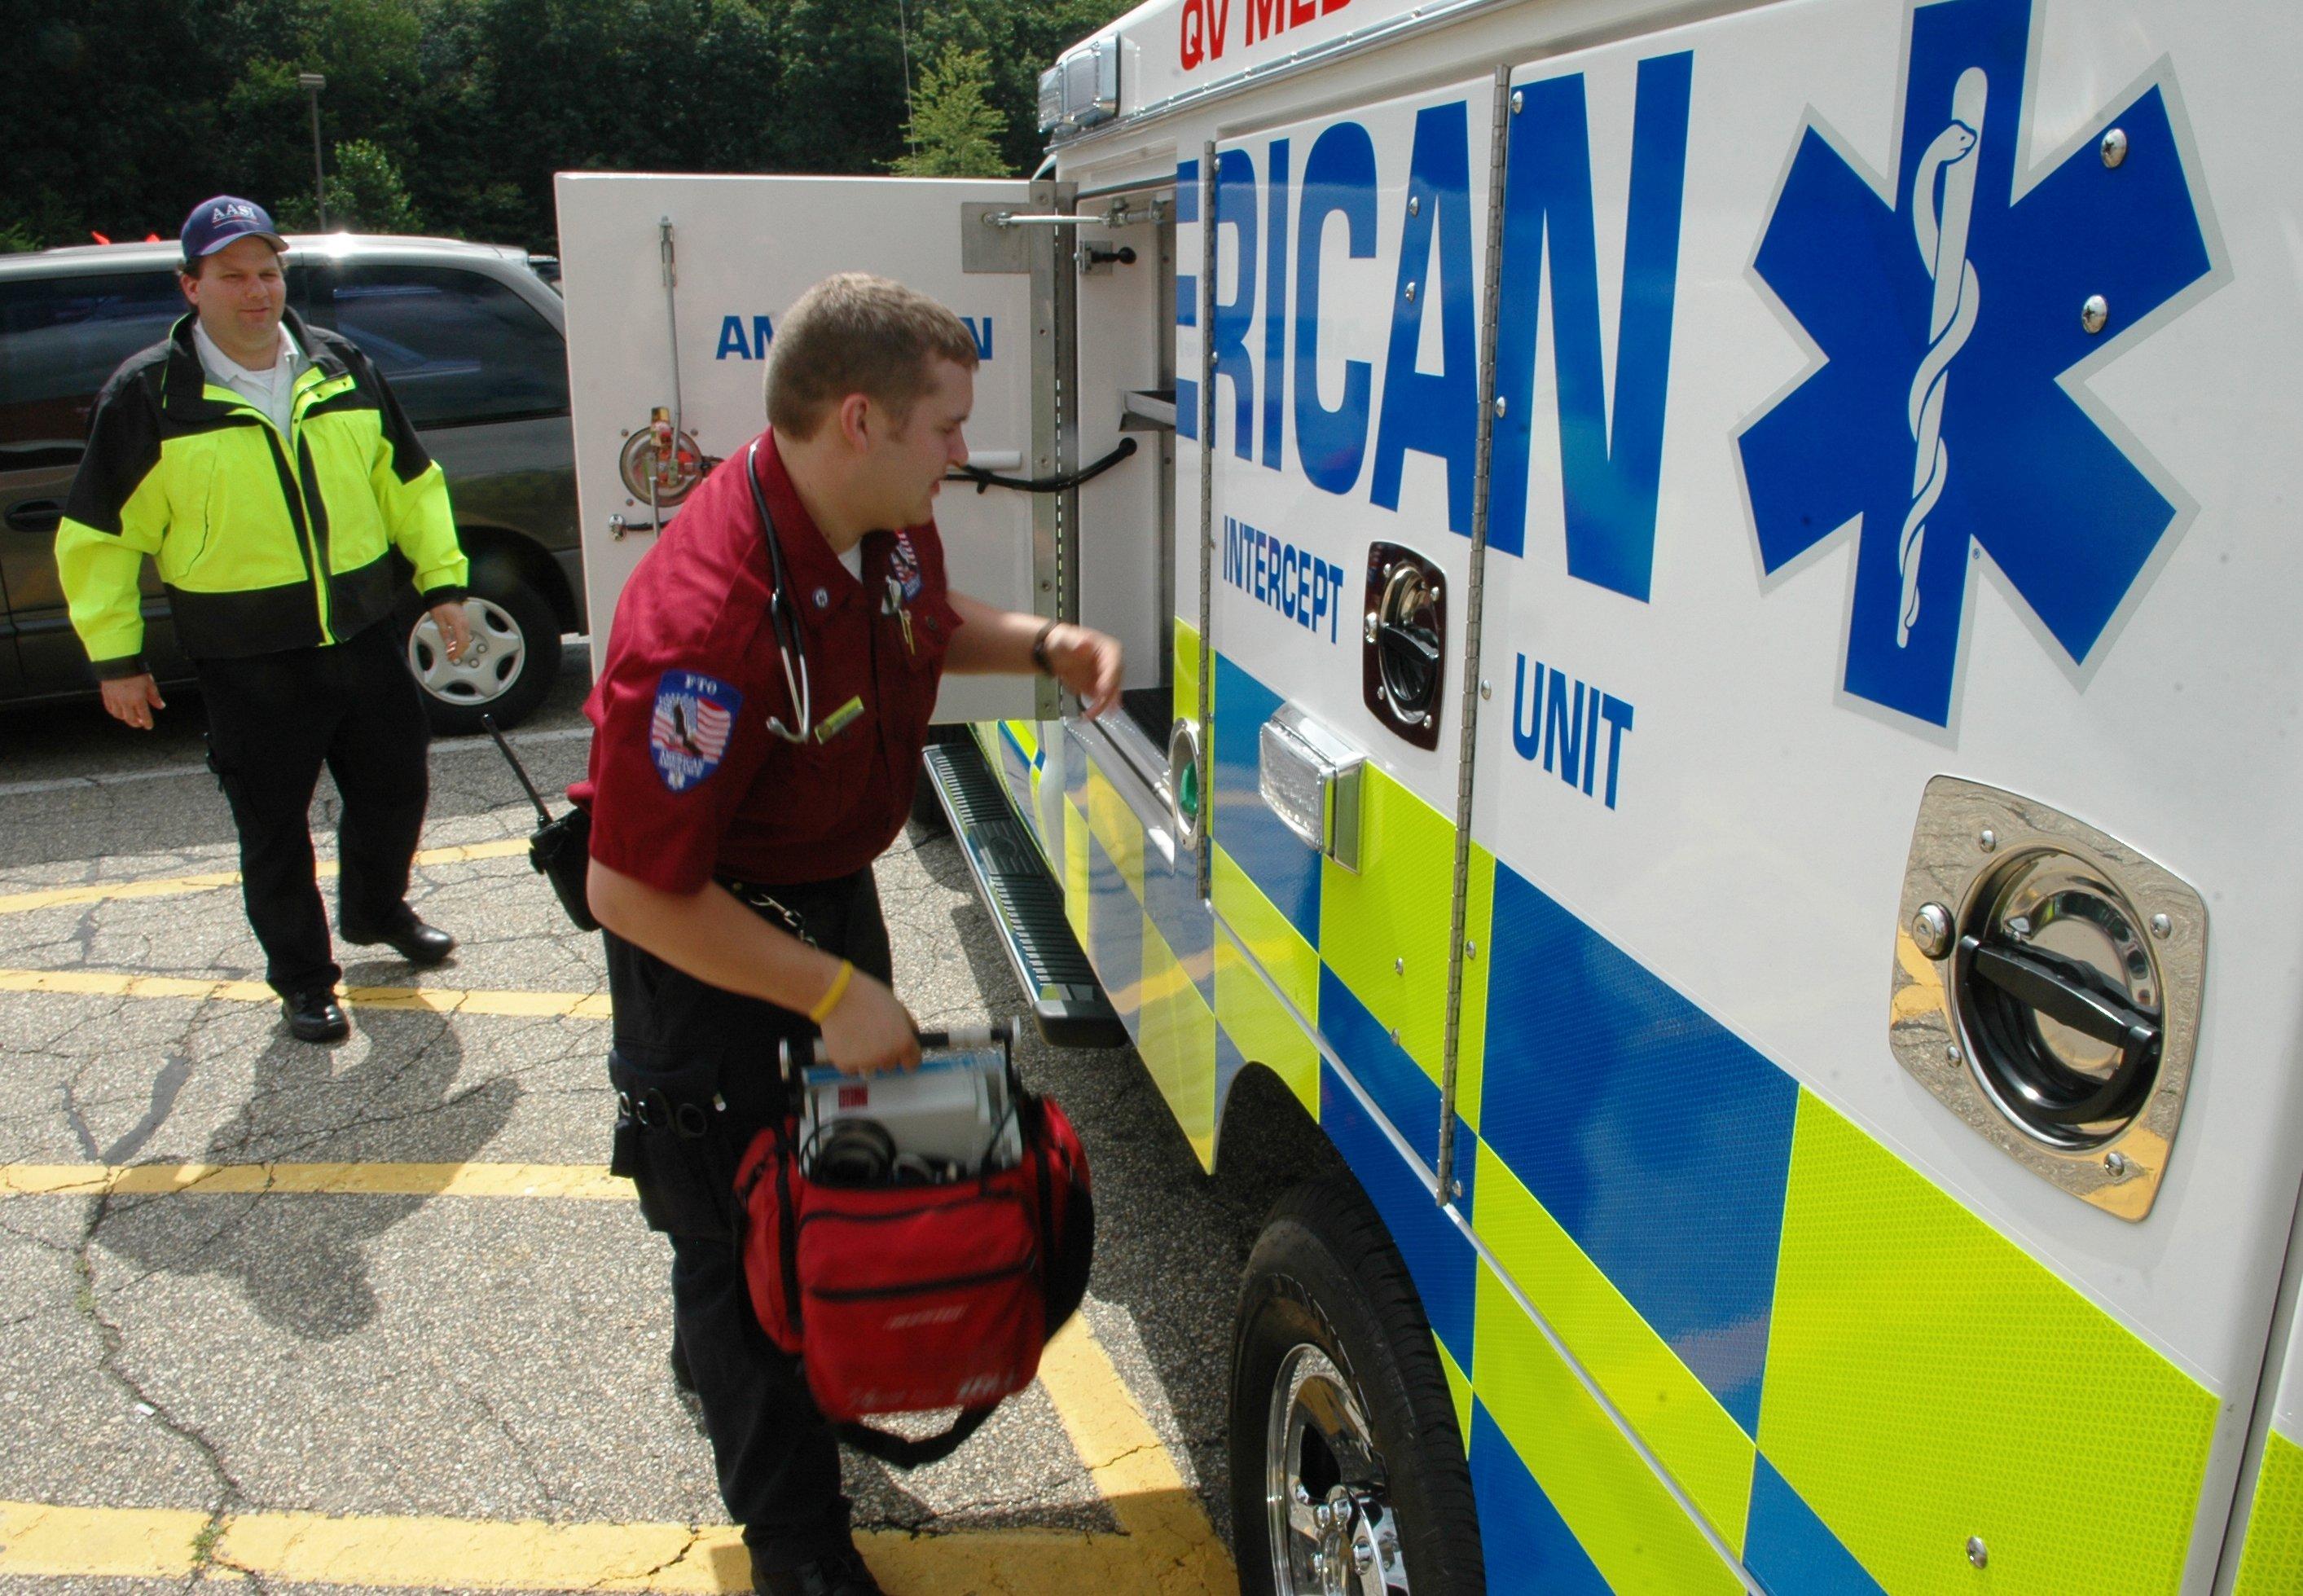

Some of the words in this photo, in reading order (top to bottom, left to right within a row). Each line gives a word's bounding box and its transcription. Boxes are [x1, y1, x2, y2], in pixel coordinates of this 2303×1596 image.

[1181, 0, 1229, 71] QV
[685, 674, 718, 695] FTO
[1224, 515, 1344, 644] INTERCEPT
[1513, 652, 1634, 811] UNIT
